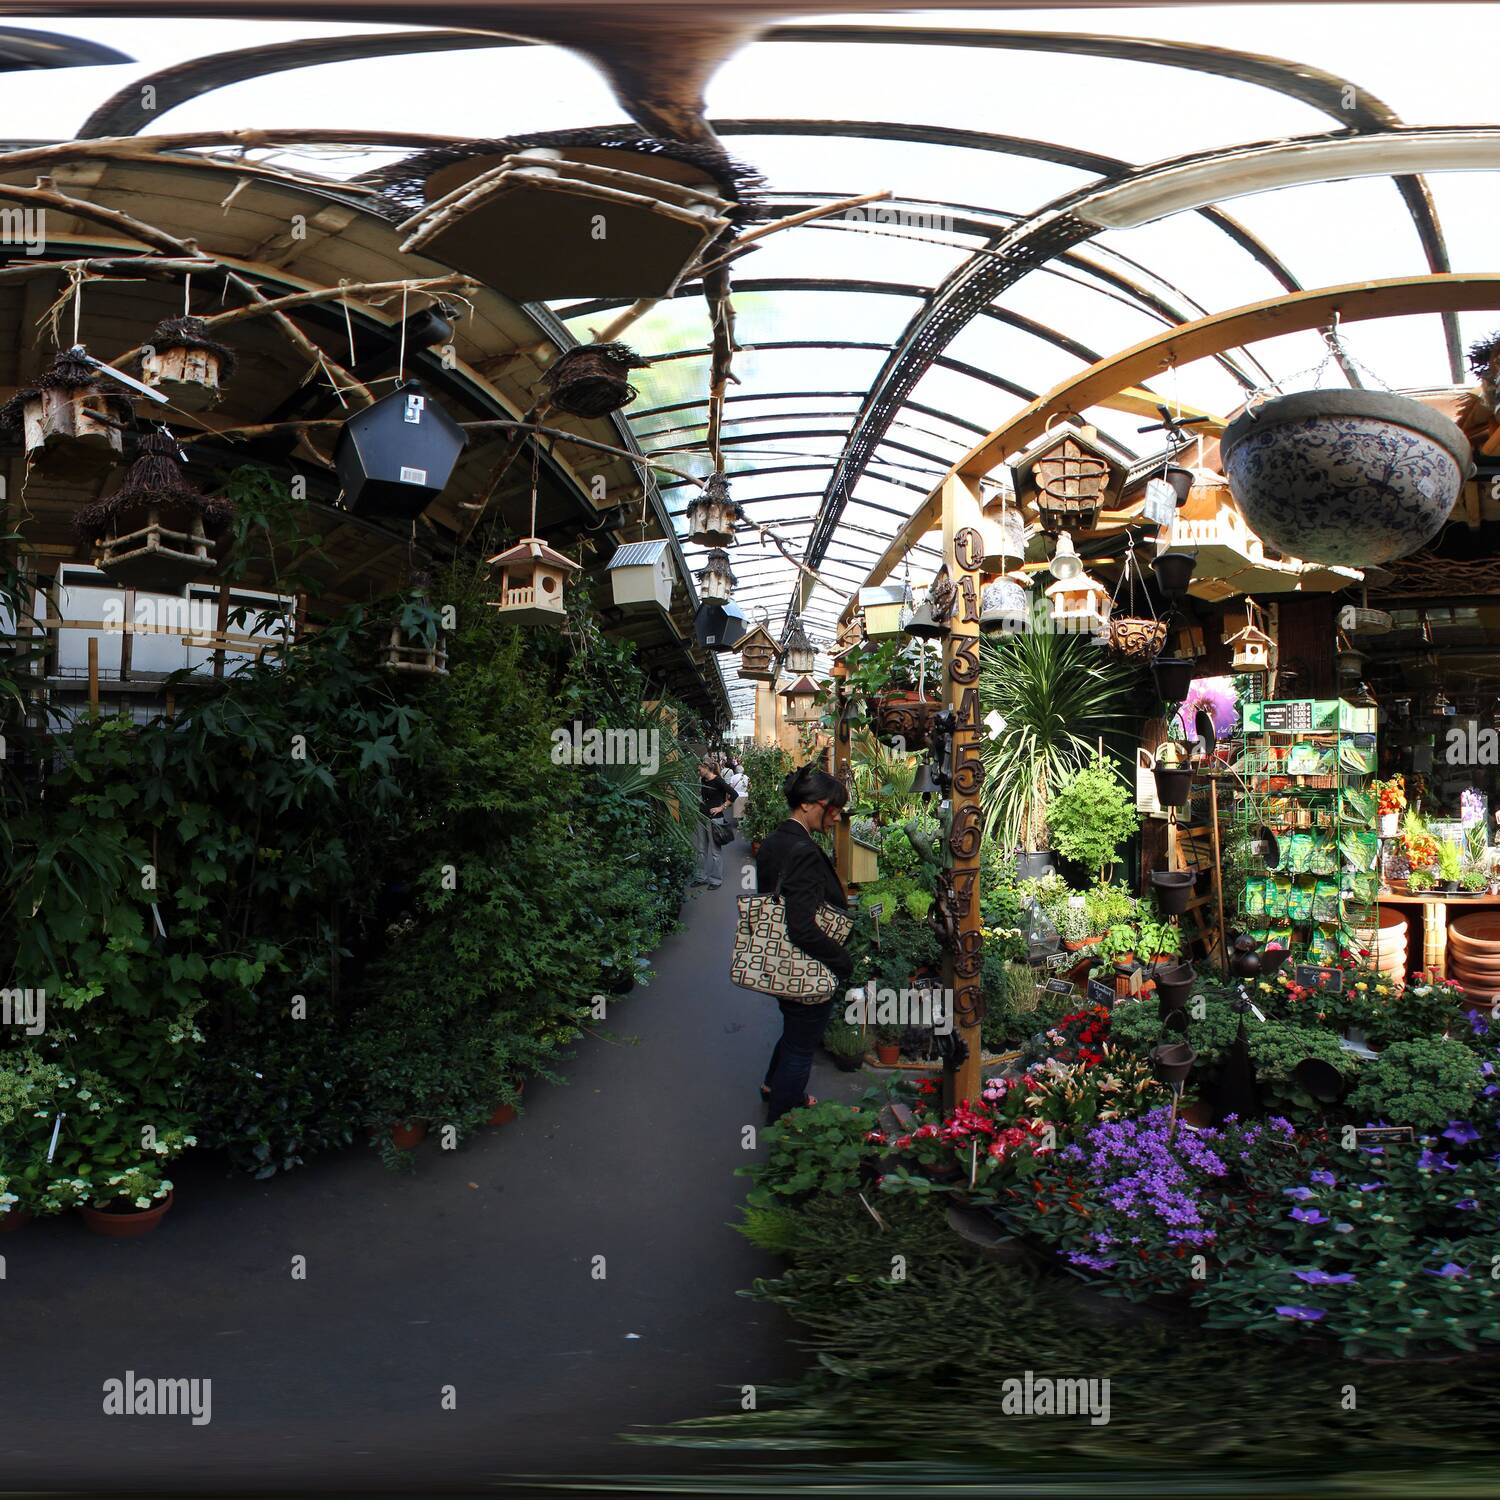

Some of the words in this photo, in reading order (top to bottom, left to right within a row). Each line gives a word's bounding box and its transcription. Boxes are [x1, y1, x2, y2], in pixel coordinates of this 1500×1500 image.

[954, 527, 984, 571] 0
[957, 575, 979, 624] 1
[949, 634, 980, 685] 3
[956, 688, 984, 739] 4
[953, 743, 984, 796] 5
[949, 805, 983, 859] 6
[949, 868, 979, 917] 7
[954, 930, 984, 979] 8
[955, 985, 986, 1028] 9
